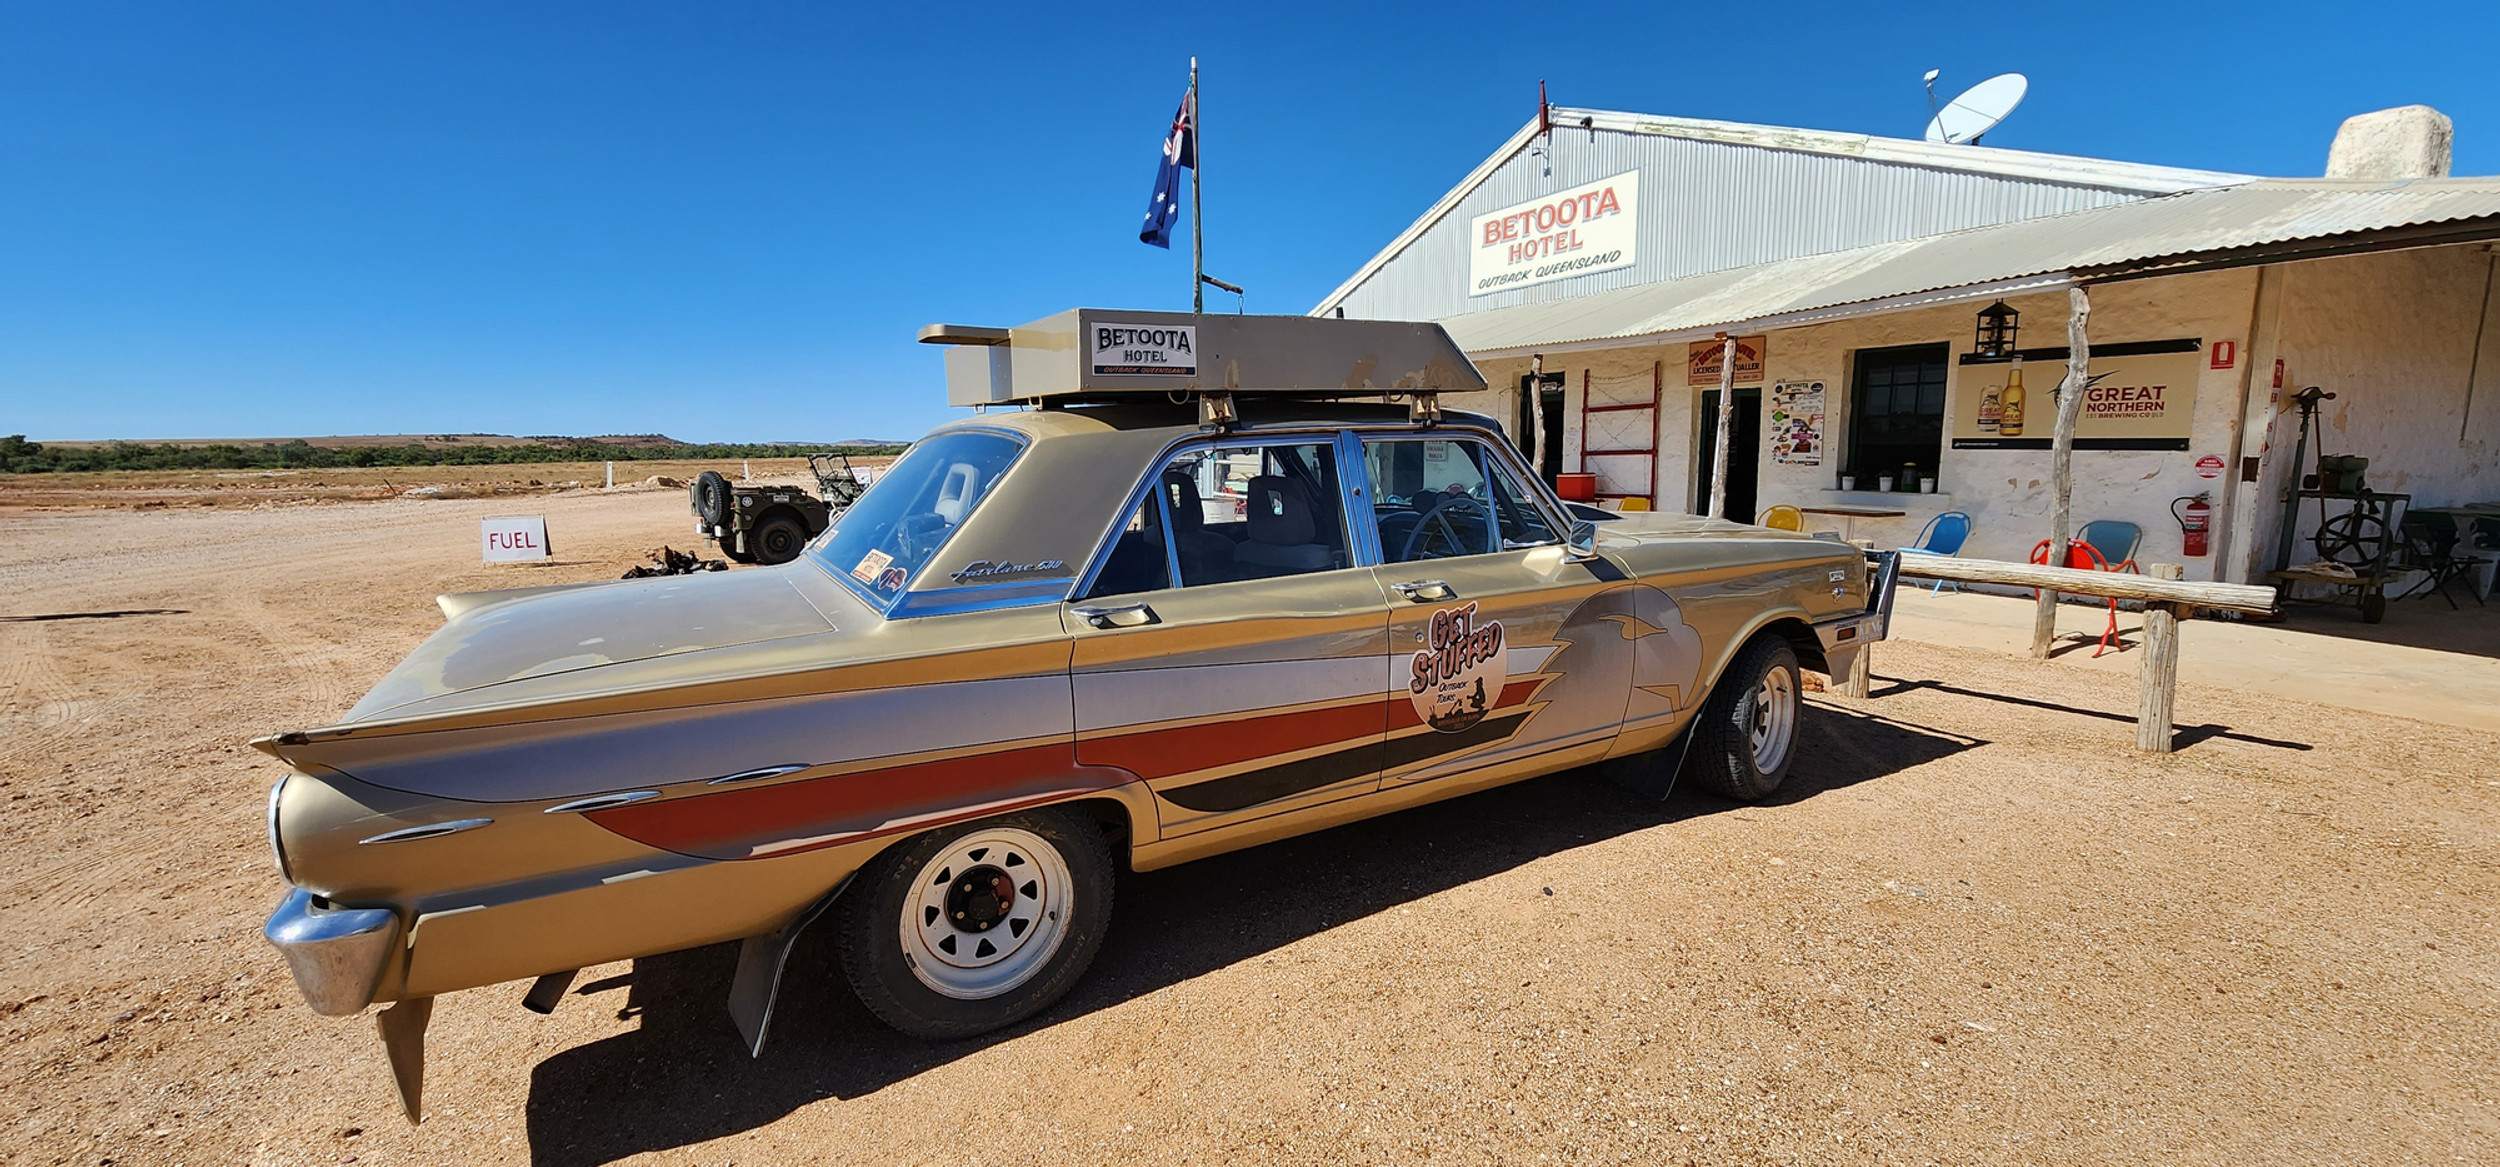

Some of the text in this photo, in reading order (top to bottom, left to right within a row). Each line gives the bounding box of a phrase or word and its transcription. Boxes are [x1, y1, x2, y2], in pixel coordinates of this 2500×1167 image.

[1481, 186, 1621, 249] BETOOTA
[1507, 228, 1584, 266] HOTEL
[1478, 250, 1622, 289] OUTBACK QUEENSLAND
[1097, 327, 1192, 356] BETOOTA
[1123, 349, 1168, 363] HOTEL
[2086, 401, 2165, 412] NORTHERN
[2087, 385, 2167, 402] GREAT
[489, 532, 538, 550] FUEL
[949, 560, 1034, 581] Fairlane
[1431, 602, 1478, 649] GET
[1410, 623, 1503, 694] STUFFED
